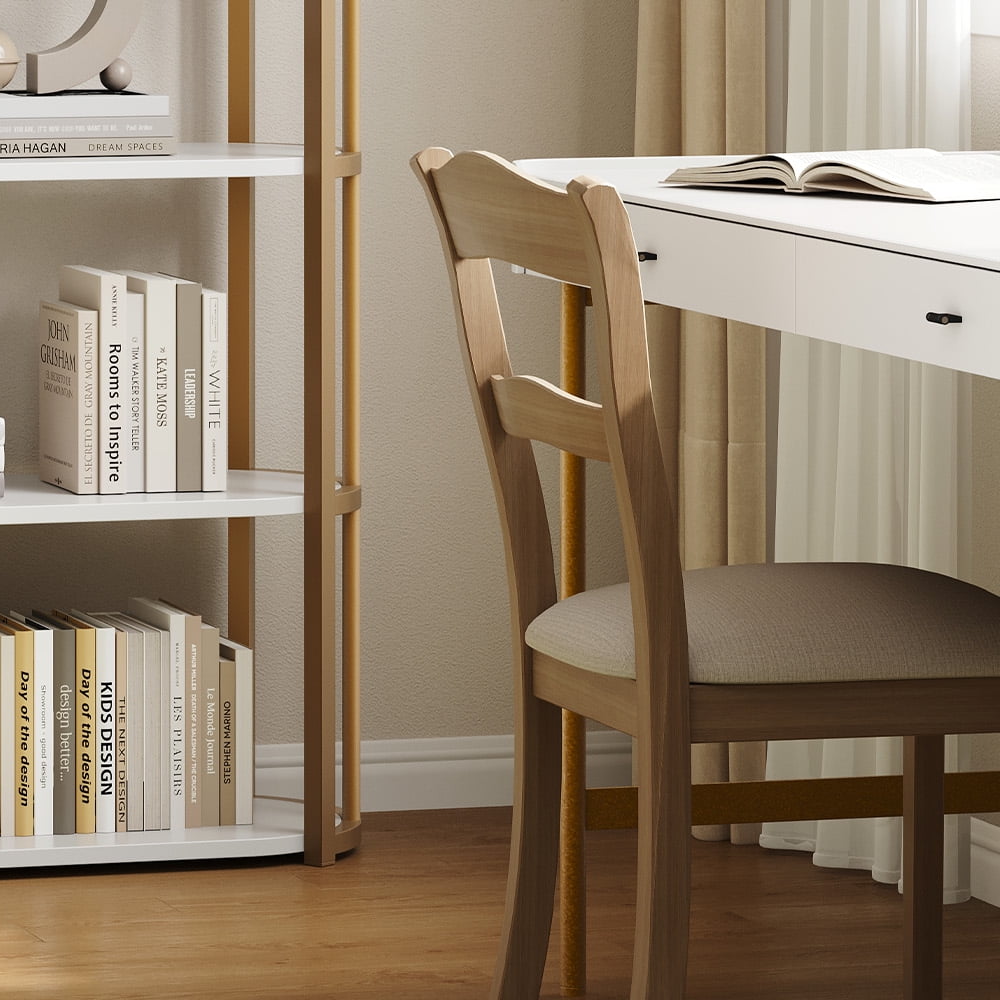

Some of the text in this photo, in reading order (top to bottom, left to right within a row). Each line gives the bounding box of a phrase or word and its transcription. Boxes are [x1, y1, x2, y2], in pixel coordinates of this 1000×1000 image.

[24, 142, 66, 154] HAGAN
[88, 144, 123, 152] DREAM
[128, 142, 164, 151] SPACES
[40, 344, 76, 372] GRISHAM
[48, 319, 69, 342] JOHN
[85, 322, 93, 485] EL SECRETO DE GRAY MOUNTAIN
[106, 344, 122, 482] Rooms to Inspire
[156, 358, 167, 427] KATE MOSS
[184, 368, 196, 419] LEADERSHIP
[208, 370, 220, 429] WHITE
[19, 671, 29, 807] Day of the design
[56, 684, 72, 782] design better...
[80, 668, 92, 804] Day of the design
[101, 682, 112, 795] KIDS DESIGN
[118, 697, 126, 823] THE NEXT DESIGN
[173, 697, 182, 796] LES PLAISIRS
[191, 714, 196, 722] OF
[206, 688, 215, 774] Le Monde Journal
[223, 701, 231, 784] STEPHEN MARINO
